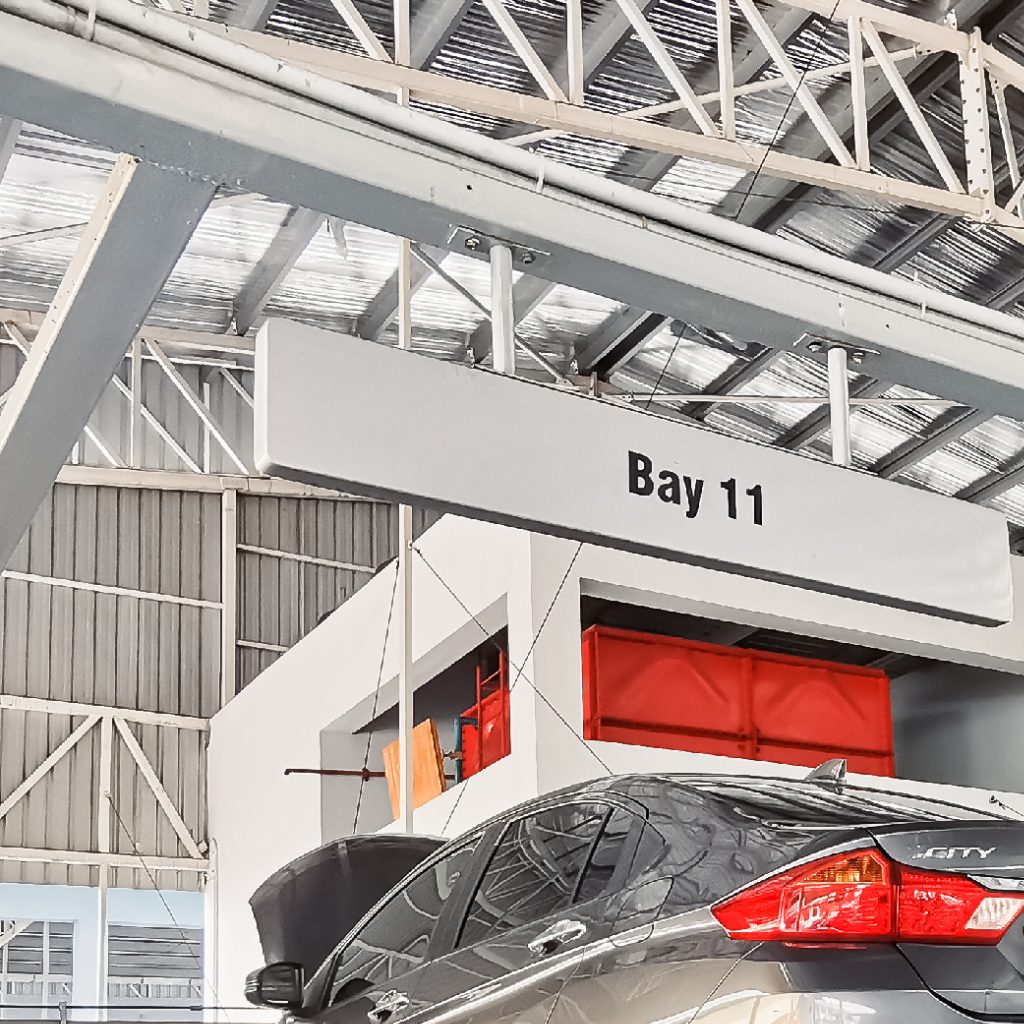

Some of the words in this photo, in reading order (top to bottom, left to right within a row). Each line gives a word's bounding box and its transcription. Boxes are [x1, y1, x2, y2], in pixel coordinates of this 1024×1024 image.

[628, 450, 704, 518] Bay
[720, 478, 763, 526] 11
[923, 847, 997, 859] CITY
